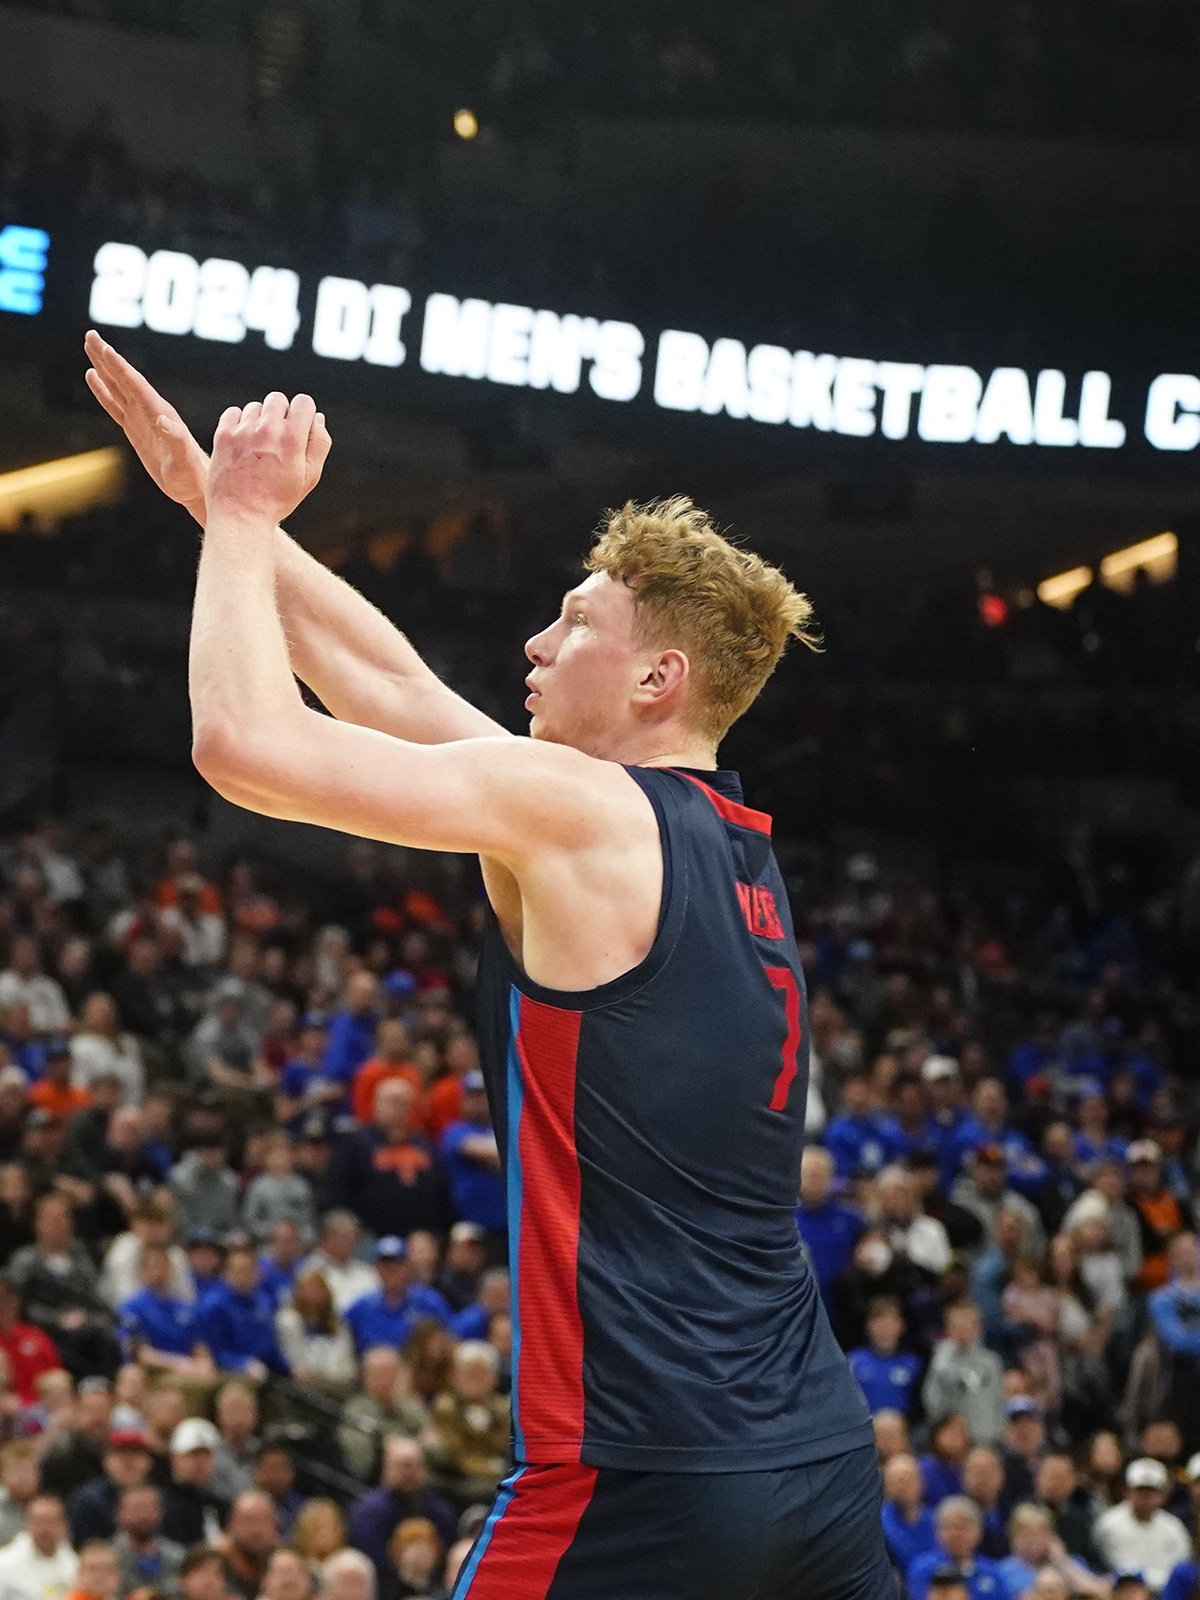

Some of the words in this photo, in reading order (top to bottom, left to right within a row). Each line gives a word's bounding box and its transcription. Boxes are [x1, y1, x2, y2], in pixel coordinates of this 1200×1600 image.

[88, 241, 300, 351] 2024
[419, 292, 645, 402] MEN'S
[653, 328, 1126, 448] BASKETBALL
[762, 965, 801, 1111] 7
